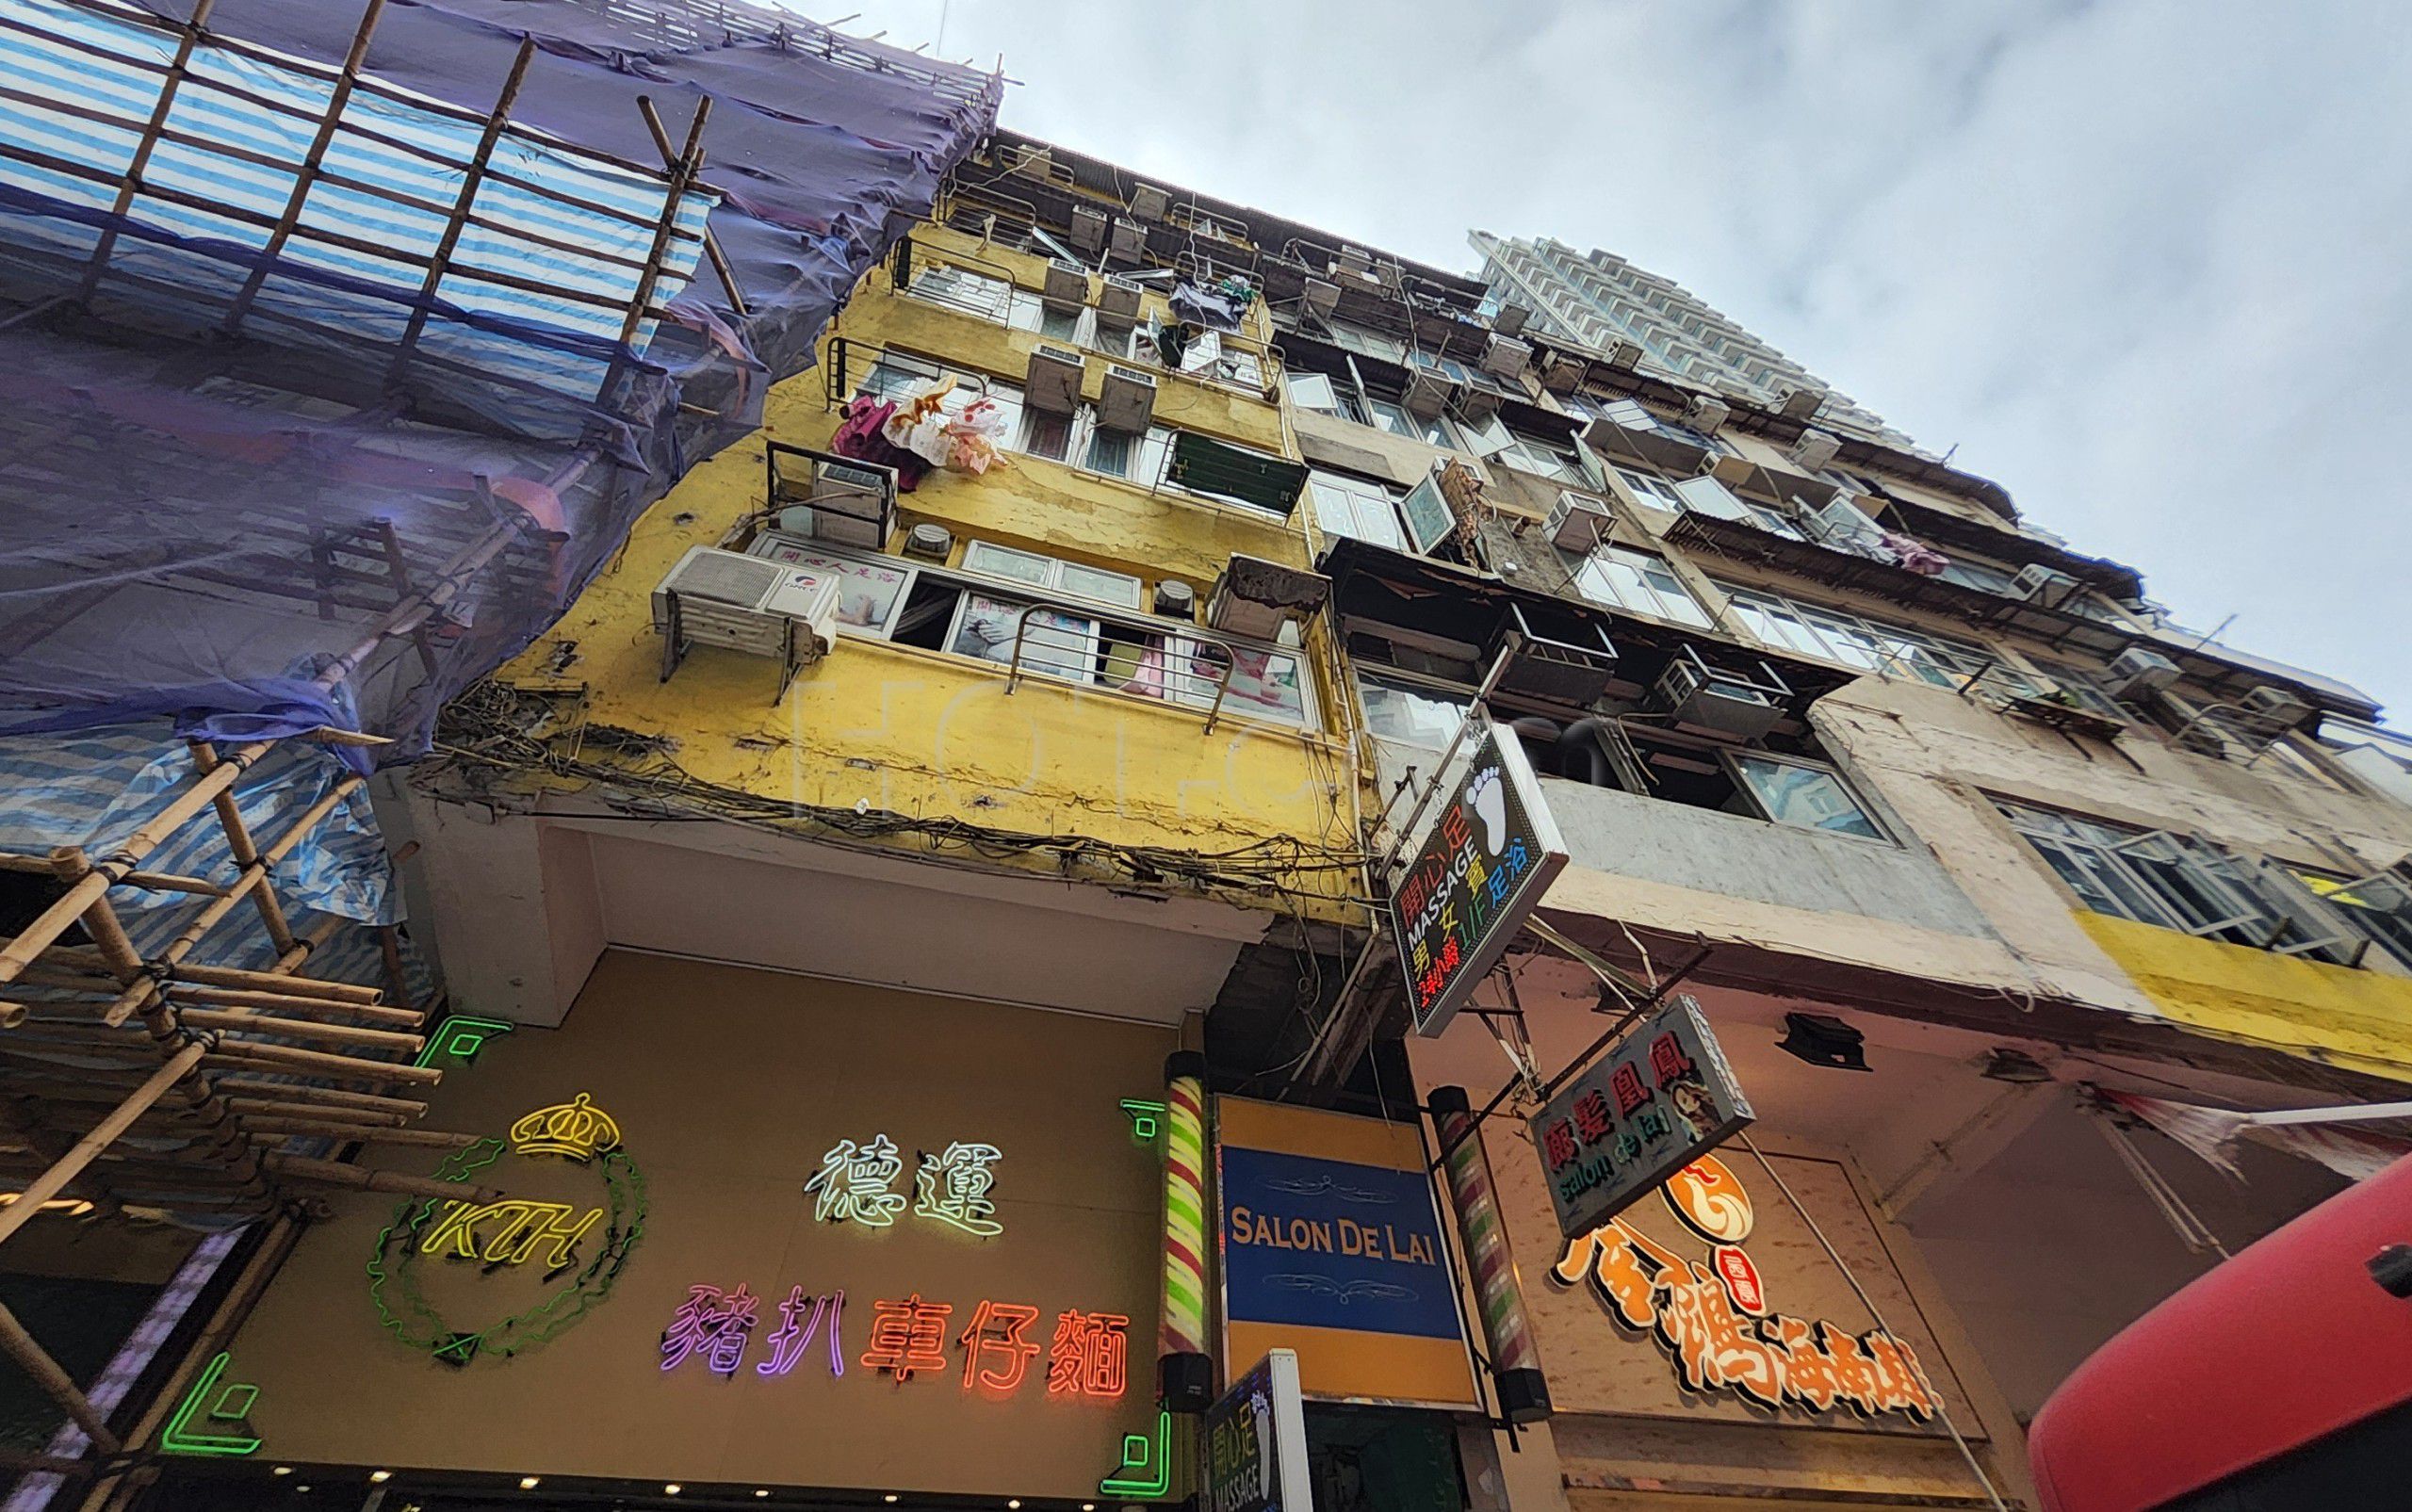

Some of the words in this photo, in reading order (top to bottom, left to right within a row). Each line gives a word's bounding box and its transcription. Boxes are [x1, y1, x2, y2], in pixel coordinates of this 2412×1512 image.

[1400, 805, 1472, 929] 開心足
[1407, 835, 1477, 951] MASSAGE
[1459, 893, 1486, 951] 1/F
[1488, 837, 1528, 908] 足浴
[804, 1133, 1003, 1236] 德運
[1559, 1155, 1612, 1201] salon
[1614, 1132, 1641, 1163] de
[1230, 1206, 1334, 1254] SALON
[1338, 1218, 1384, 1260] DE
[1385, 1225, 1437, 1266] LAI
[1213, 1401, 1256, 1480] 開心足
[1214, 1463, 1260, 1512] MASSAGE
